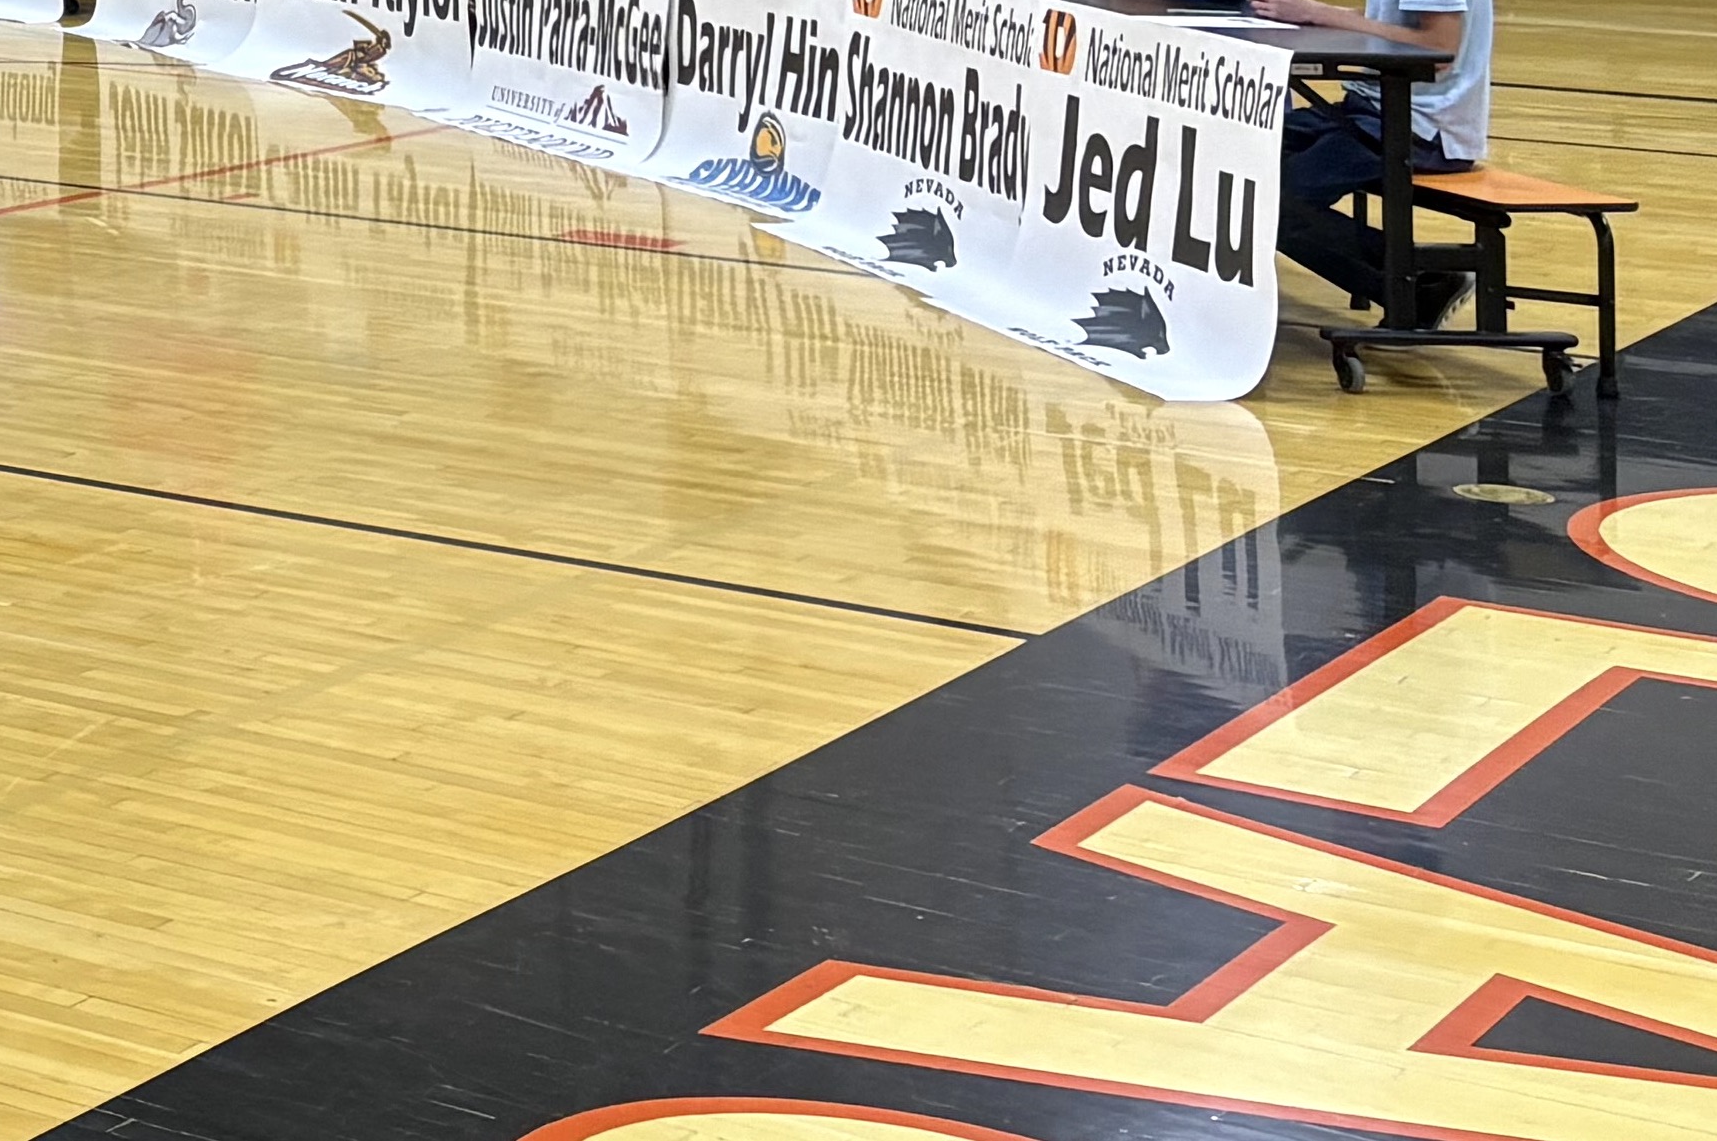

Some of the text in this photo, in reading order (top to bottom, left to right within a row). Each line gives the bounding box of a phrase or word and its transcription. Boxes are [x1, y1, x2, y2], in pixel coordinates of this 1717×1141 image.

[491, 85, 554, 117] UNIVERSITY
[775, 16, 839, 122] Hin
[1085, 28, 1285, 130] National Merit Scholar
[842, 31, 1031, 225] Shannon Brady
[904, 178, 965, 220] NEVADA
[1042, 94, 1256, 288] Jed Lu
[1103, 255, 1174, 302] NEVADA
